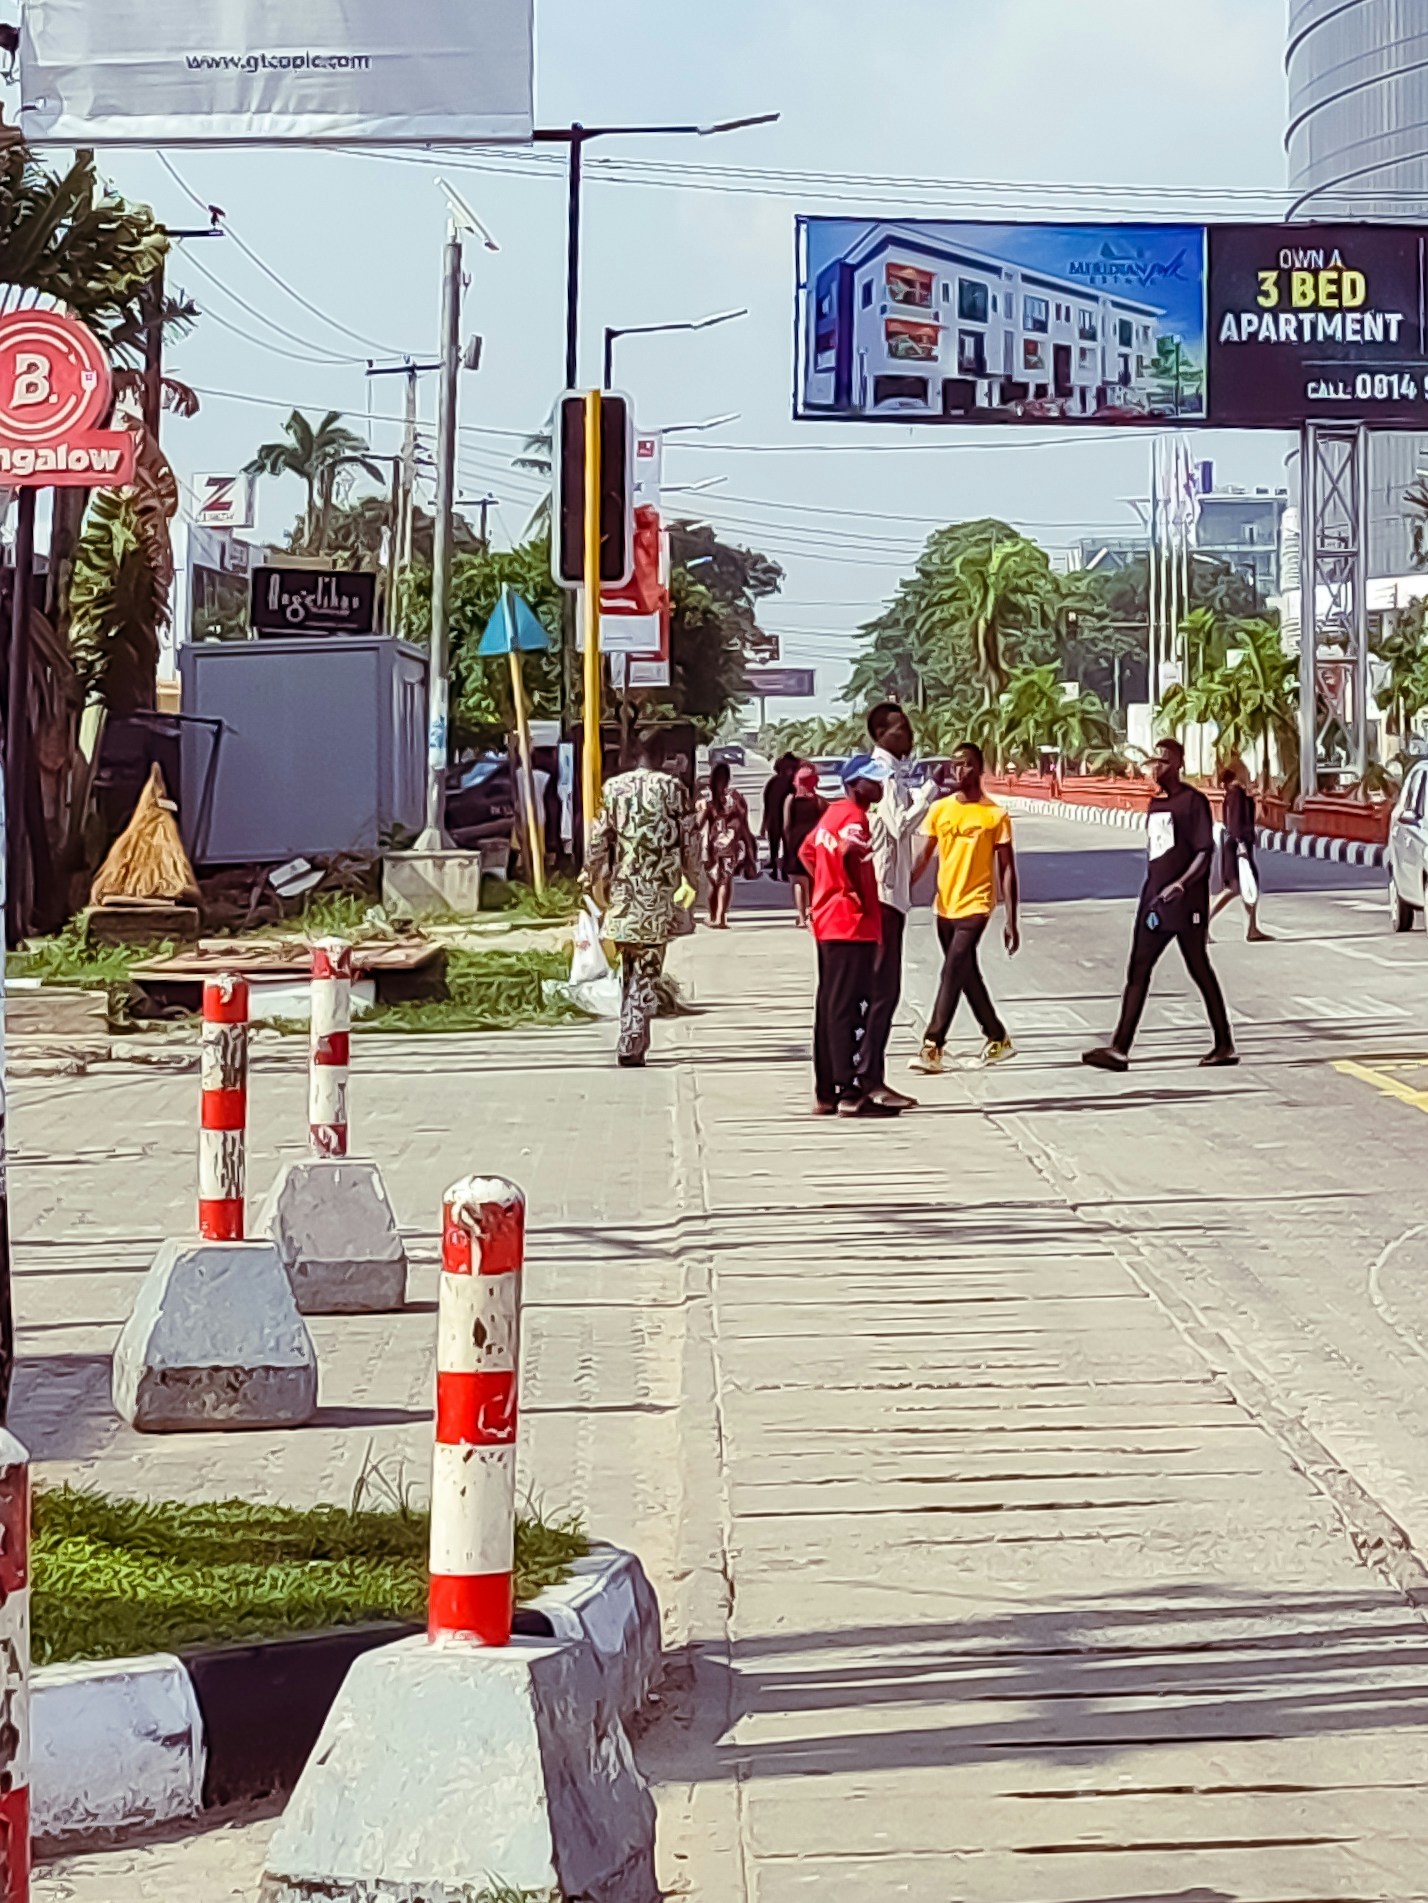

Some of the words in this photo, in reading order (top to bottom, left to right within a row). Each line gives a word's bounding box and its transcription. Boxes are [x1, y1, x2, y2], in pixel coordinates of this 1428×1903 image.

[1280, 248, 1324, 270] OWN
[1327, 248, 1347, 270] A
[1256, 270, 1280, 308] 3
[1291, 270, 1367, 308] BED
[1218, 312, 1405, 344] APARTMENT
